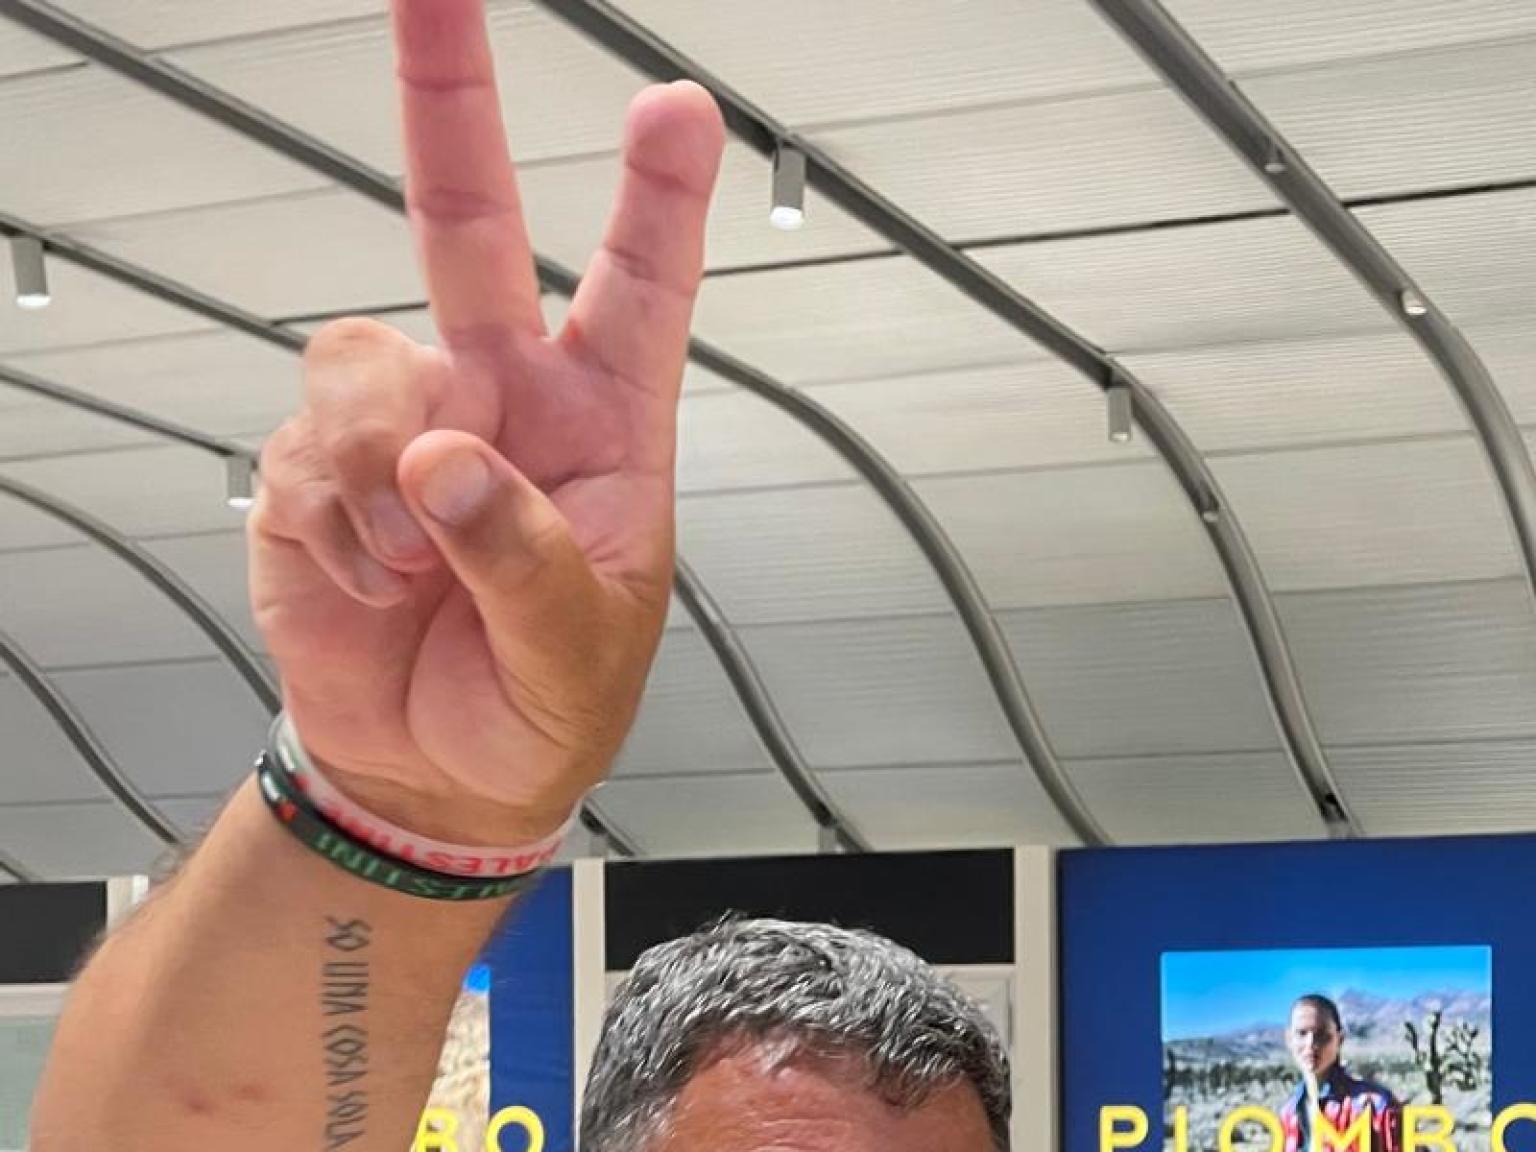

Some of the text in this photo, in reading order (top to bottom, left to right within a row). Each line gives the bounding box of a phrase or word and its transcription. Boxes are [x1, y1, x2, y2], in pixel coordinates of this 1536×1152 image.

[324, 916, 372, 951] SO
[321, 961, 370, 1016] UNA
[321, 1024, 369, 1087] COSA
